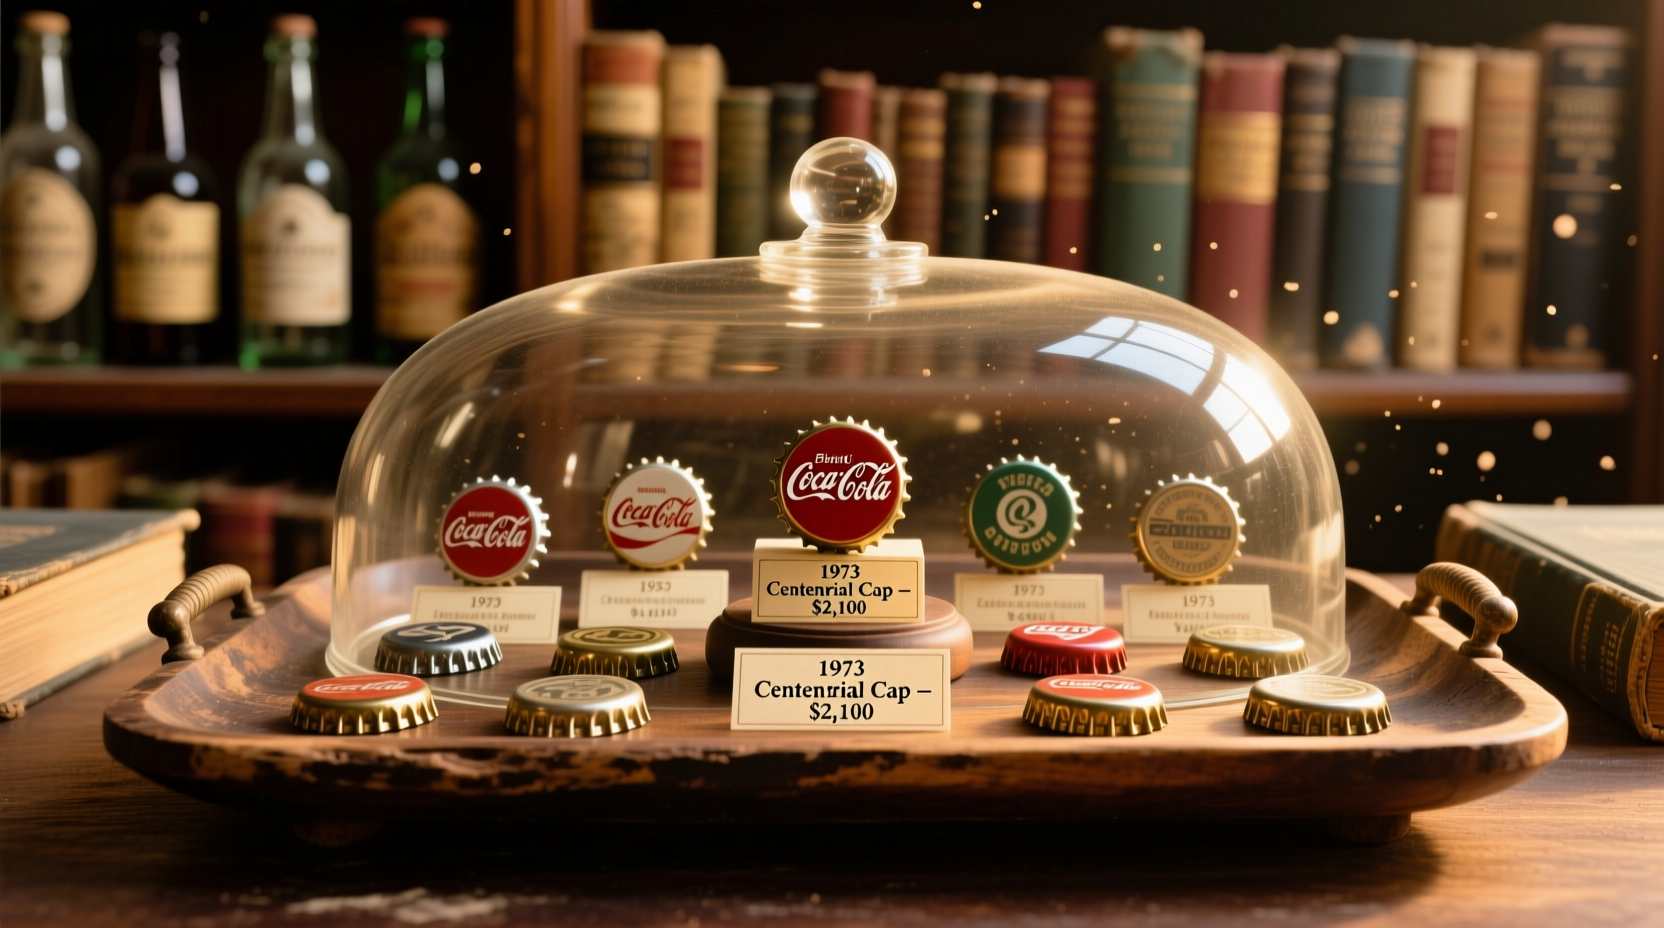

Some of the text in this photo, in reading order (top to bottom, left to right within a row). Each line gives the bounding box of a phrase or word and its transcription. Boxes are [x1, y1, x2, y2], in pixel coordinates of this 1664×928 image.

[821, 564, 860, 579] 1973
[859, 582, 893, 601] Cap
[812, 599, 866, 618] $2,100
[820, 660, 865, 677] 1973
[871, 681, 910, 704] Cap
[809, 702, 874, 723] $2,100
